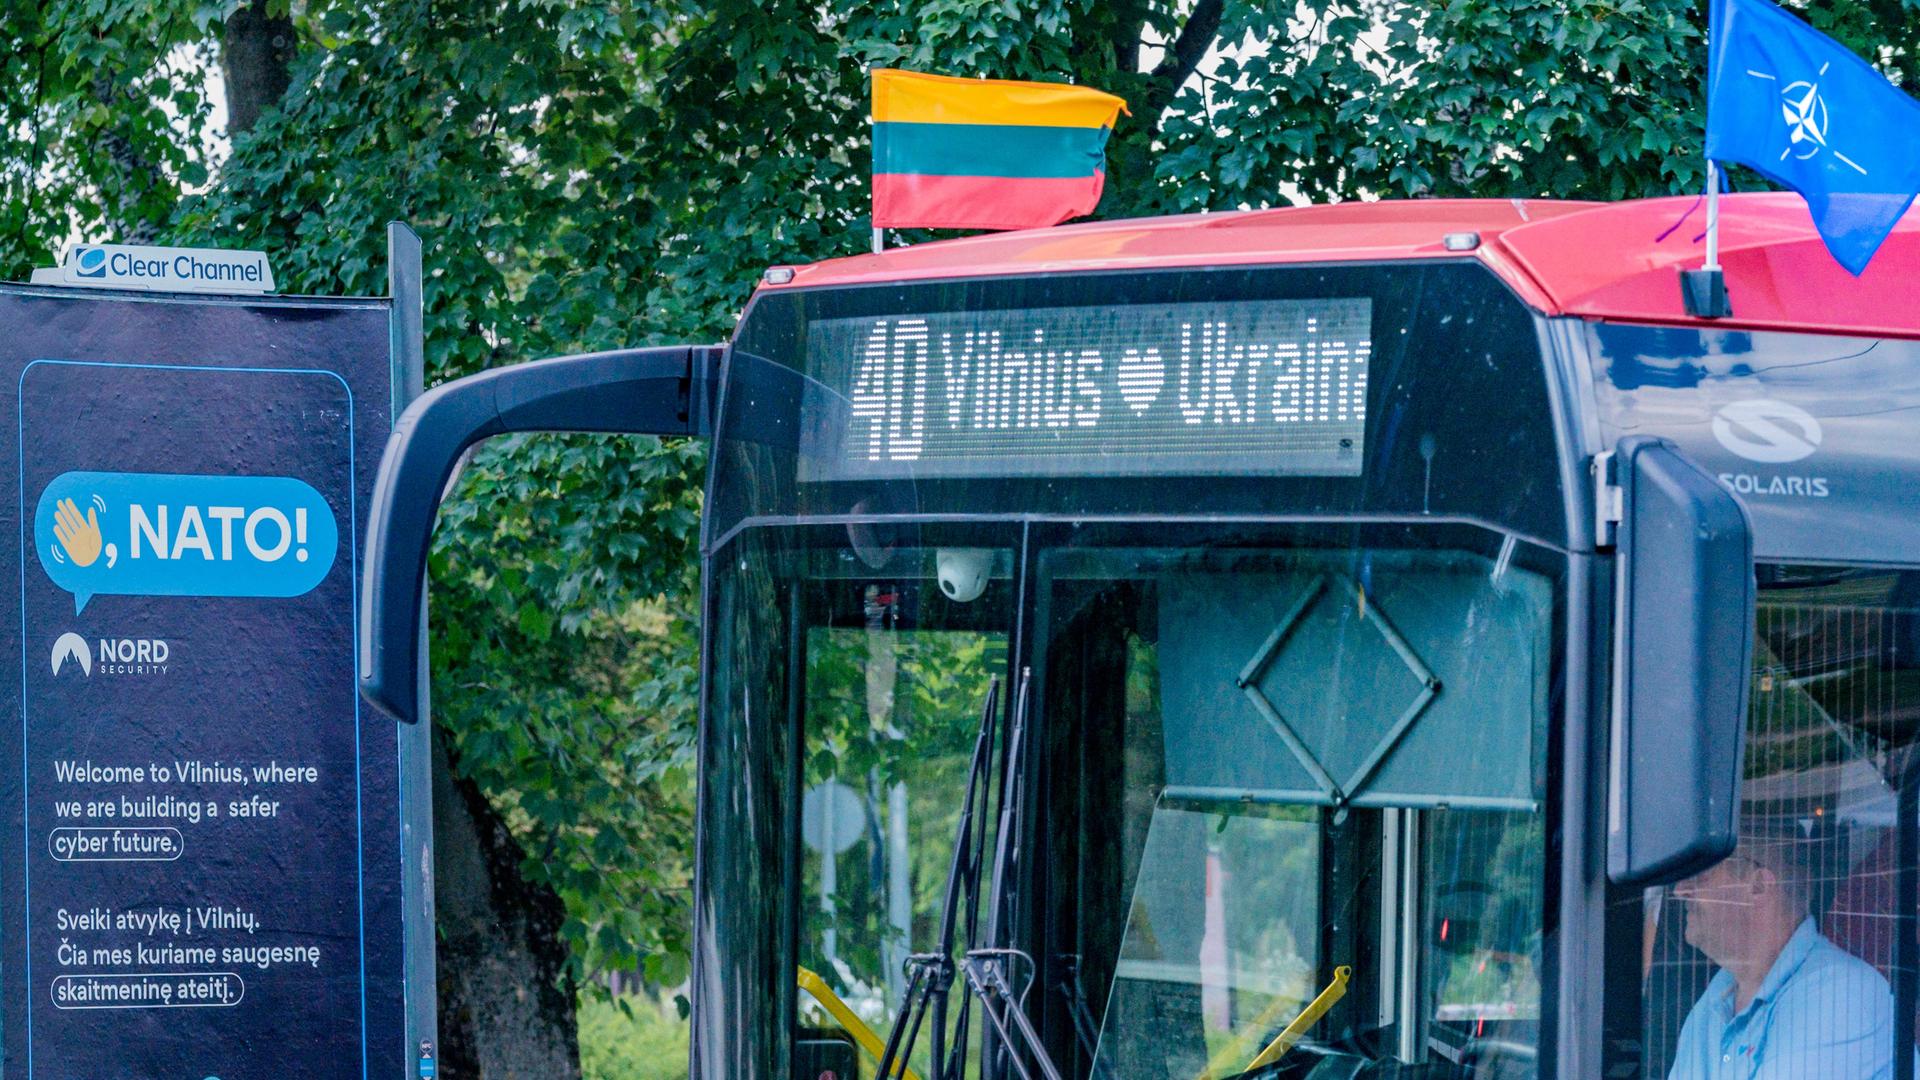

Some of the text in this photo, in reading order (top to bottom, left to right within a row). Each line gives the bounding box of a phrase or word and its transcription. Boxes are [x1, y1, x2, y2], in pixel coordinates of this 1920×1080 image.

[110, 252, 263, 282] Clear Channel
[852, 318, 928, 462] 40
[942, 329, 1102, 429] Vilnius
[1717, 472, 1829, 498] SOLARIS
[129, 503, 309, 563] NATO!
[100, 638, 169, 664] NORD
[100, 665, 169, 677] SECURITY
[54, 760, 319, 787] Welcome to Vilnius, where
[55, 795, 280, 824] we are building a safer
[55, 831, 178, 860] cyber future.
[56, 907, 260, 936] Sveiki atvykę į Vilnių.
[56, 938, 321, 971] Čia mes kuriame saugesnę
[57, 977, 235, 1005] skaitmeninę ateitį.
